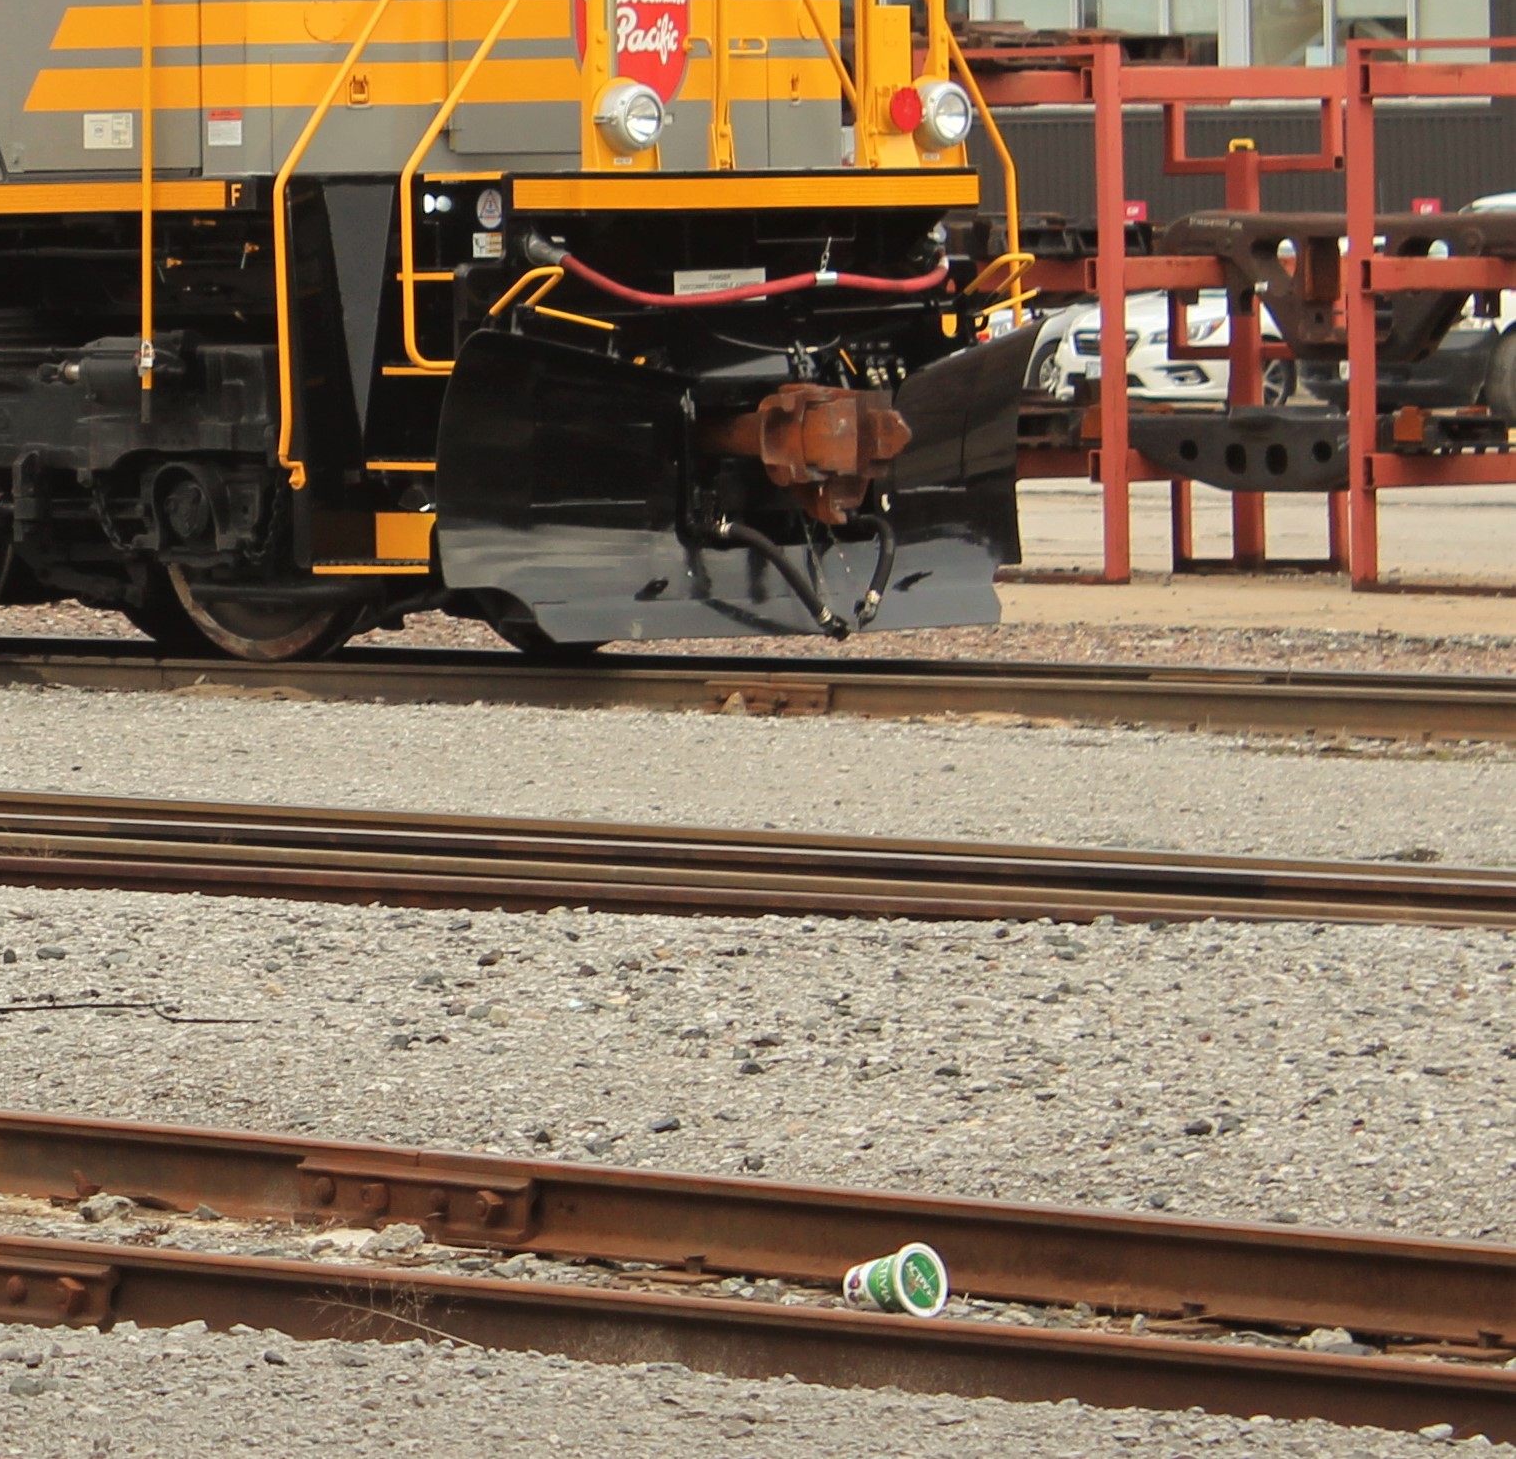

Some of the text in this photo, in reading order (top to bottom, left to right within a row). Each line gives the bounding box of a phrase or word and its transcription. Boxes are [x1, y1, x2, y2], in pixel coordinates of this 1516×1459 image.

[616, 5, 679, 66] Pacific
[230, 182, 243, 208] F
[708, 273, 732, 281] DANGER
